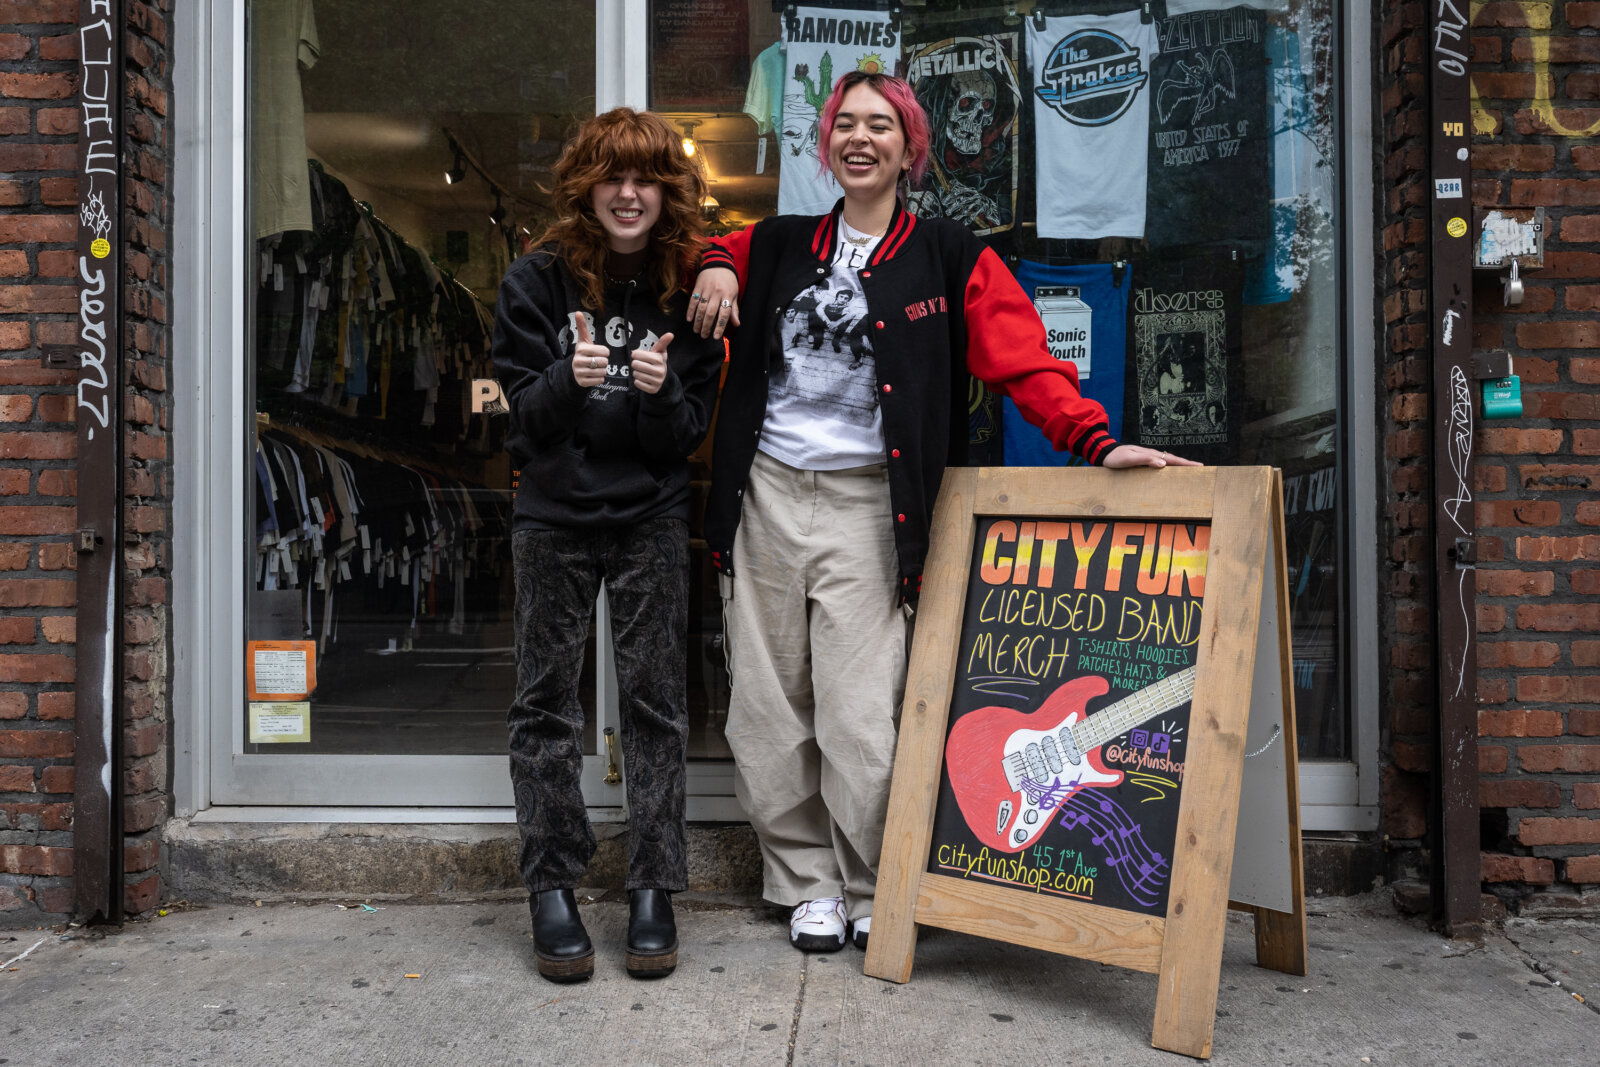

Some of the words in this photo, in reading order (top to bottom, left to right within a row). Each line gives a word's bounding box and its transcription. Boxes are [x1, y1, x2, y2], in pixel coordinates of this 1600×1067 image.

[787, 17, 897, 48] RAMONES
[905, 36, 1023, 98] METALLICA
[1058, 46, 1090, 63] The
[1046, 60, 1141, 97] Strokes
[904, 300, 928, 322] GUNS
[1047, 327, 1087, 343] Sonic
[1047, 344, 1086, 360] Youth
[979, 588, 1106, 633] LICENSED
[1116, 596, 1205, 647] BAND
[967, 632, 1070, 679] MERCH
[1156, 665, 1168, 680] &
[1033, 844, 1054, 868] 45
[1055, 849, 1076, 873] 1st
[1074, 851, 1098, 878] Ave
